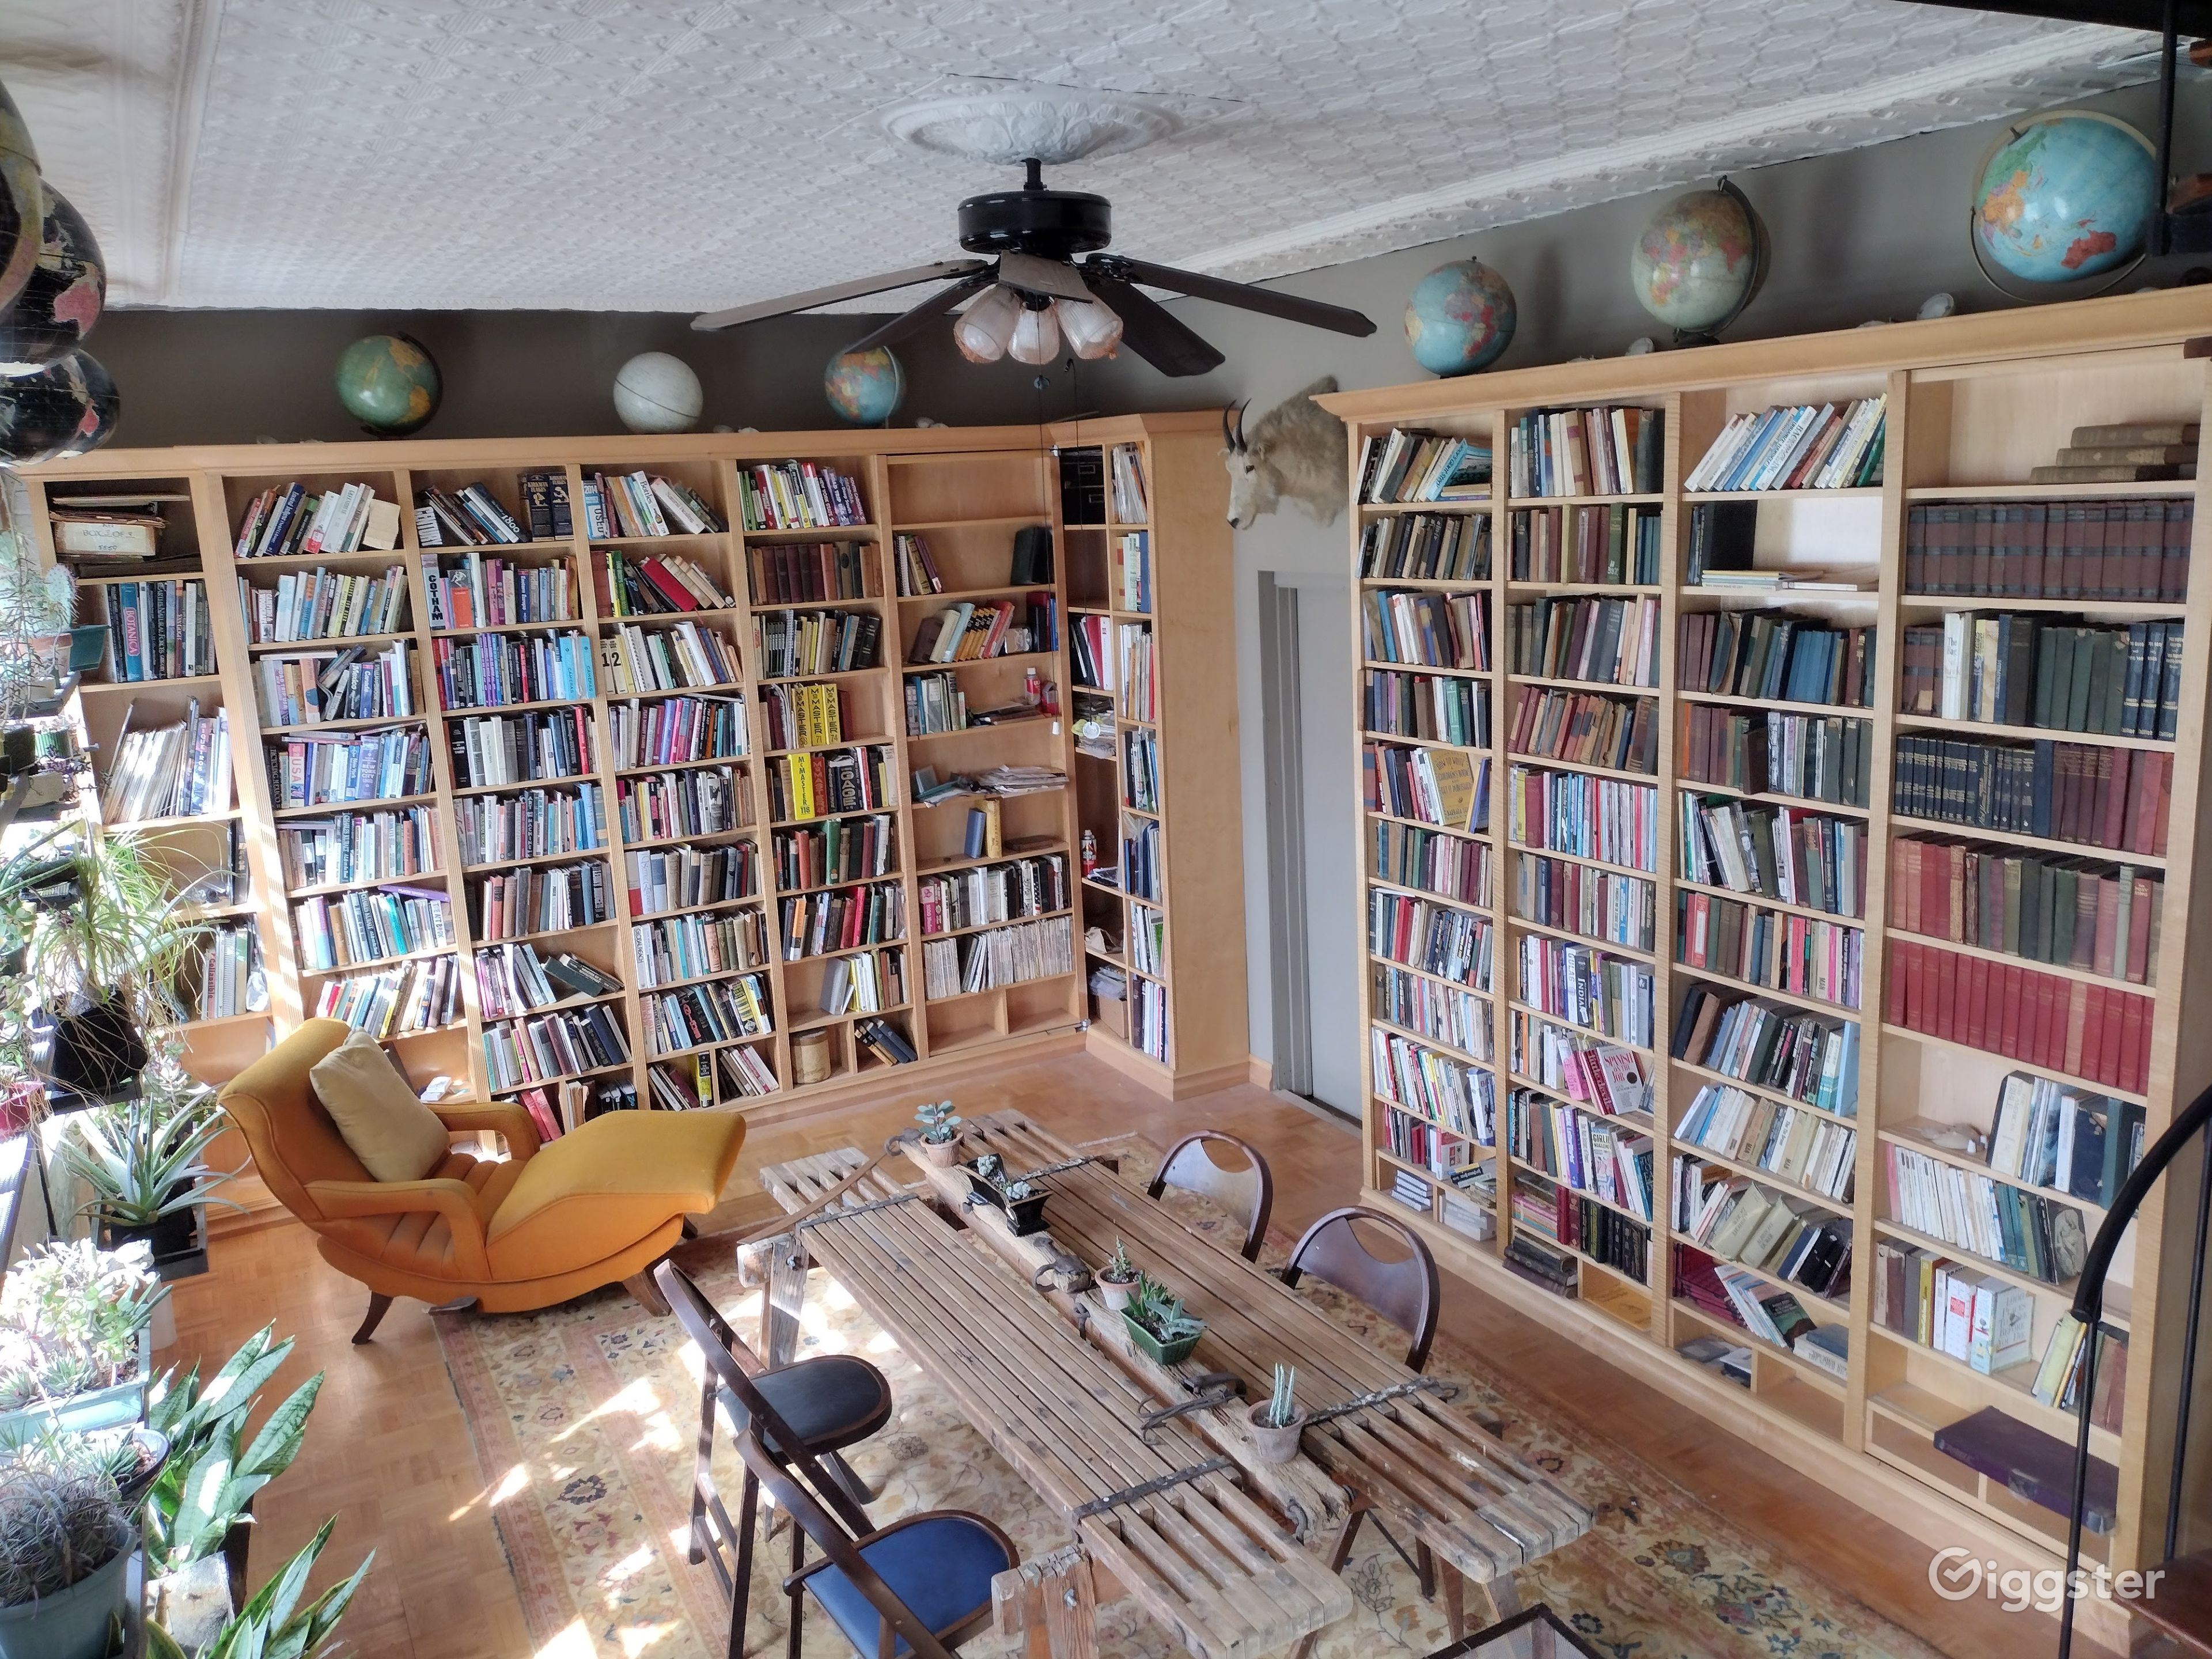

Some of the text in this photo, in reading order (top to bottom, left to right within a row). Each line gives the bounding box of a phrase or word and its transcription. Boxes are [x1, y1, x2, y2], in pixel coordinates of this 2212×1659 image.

[1766, 422, 1804, 476] BACKPACKING
[584, 484, 597, 494] 2014
[641, 480, 653, 505] Bottles
[819, 476, 833, 517] NEW YORK STATE
[830, 472, 844, 515] ROAD TRIP USA
[849, 476, 863, 515] SOUTH CAROLINA
[415, 506, 442, 547] CENTURY
[501, 513, 519, 533] 1800
[594, 508, 604, 533] USED
[428, 574, 443, 620] GOTHAM
[124, 609, 138, 653] BOTANICA
[1947, 637, 1957, 646] The
[350, 664, 360, 690] Mexico
[795, 690, 806, 737] McMASTER
[810, 688, 822, 735] McMASTER
[825, 686, 838, 733] McMASTER
[198, 723, 207, 771] SIQUEIROS
[816, 735, 822, 744] 71
[830, 734, 838, 742] 74
[270, 749, 282, 803] BICYCLING MEXICO
[291, 758, 301, 782] USA
[1436, 760, 1447, 770] HOW
[797, 755, 808, 806] McMASTER
[800, 806, 810, 814] 118
[361, 893, 370, 912] CHARLES
[207, 959, 216, 998] Collapsible
[652, 1003, 661, 1033] ROTTWEILERS
[1603, 1051, 1634, 1067] SPANISH
[1611, 1069, 1626, 1083] JOB
